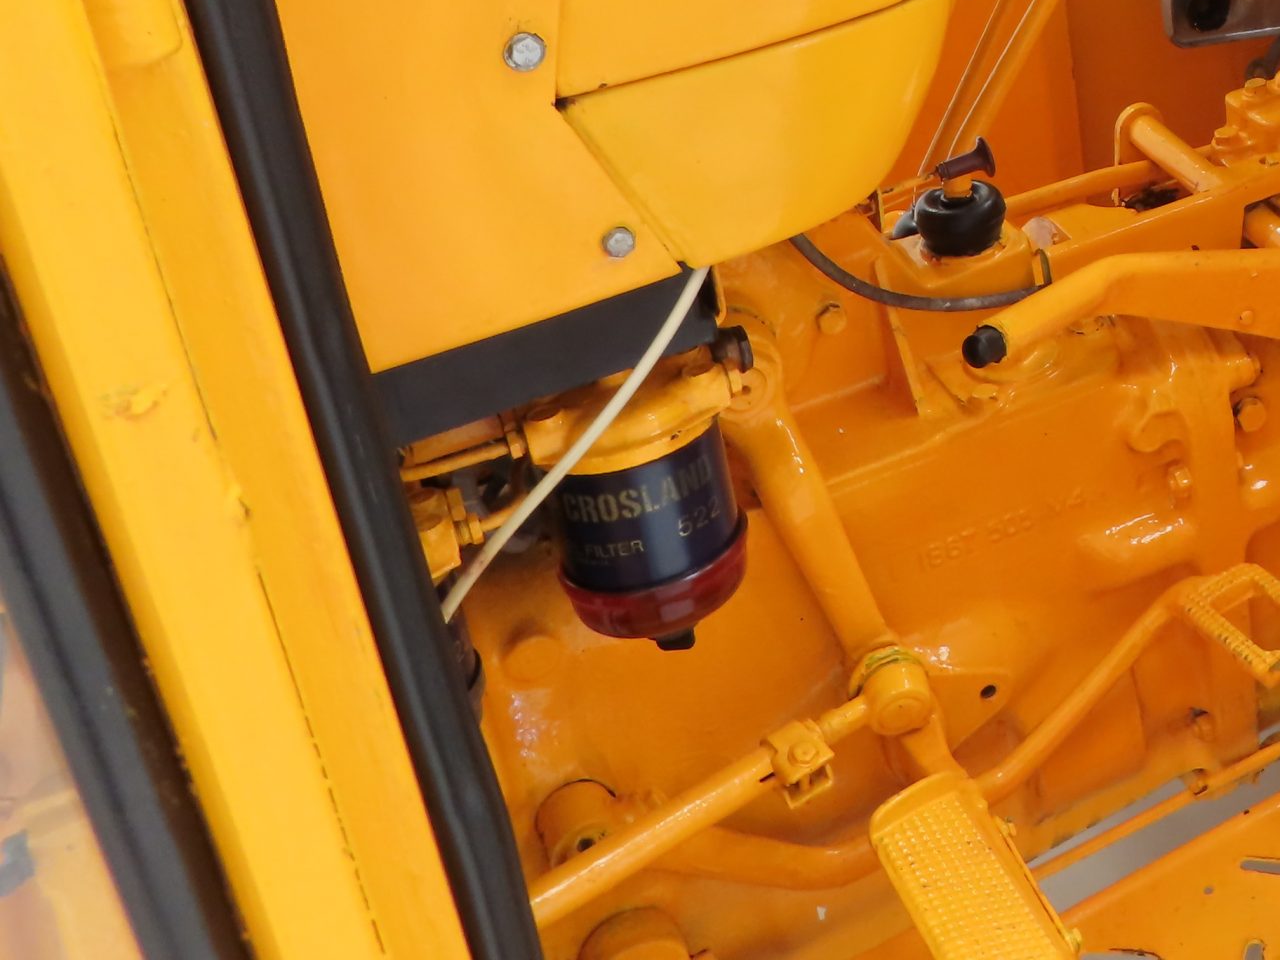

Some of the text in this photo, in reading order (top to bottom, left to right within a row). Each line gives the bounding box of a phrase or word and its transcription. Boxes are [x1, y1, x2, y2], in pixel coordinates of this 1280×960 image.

[563, 454, 711, 523] CROSLAND
[678, 495, 721, 537] 522
[585, 539, 645, 558] FILTER
